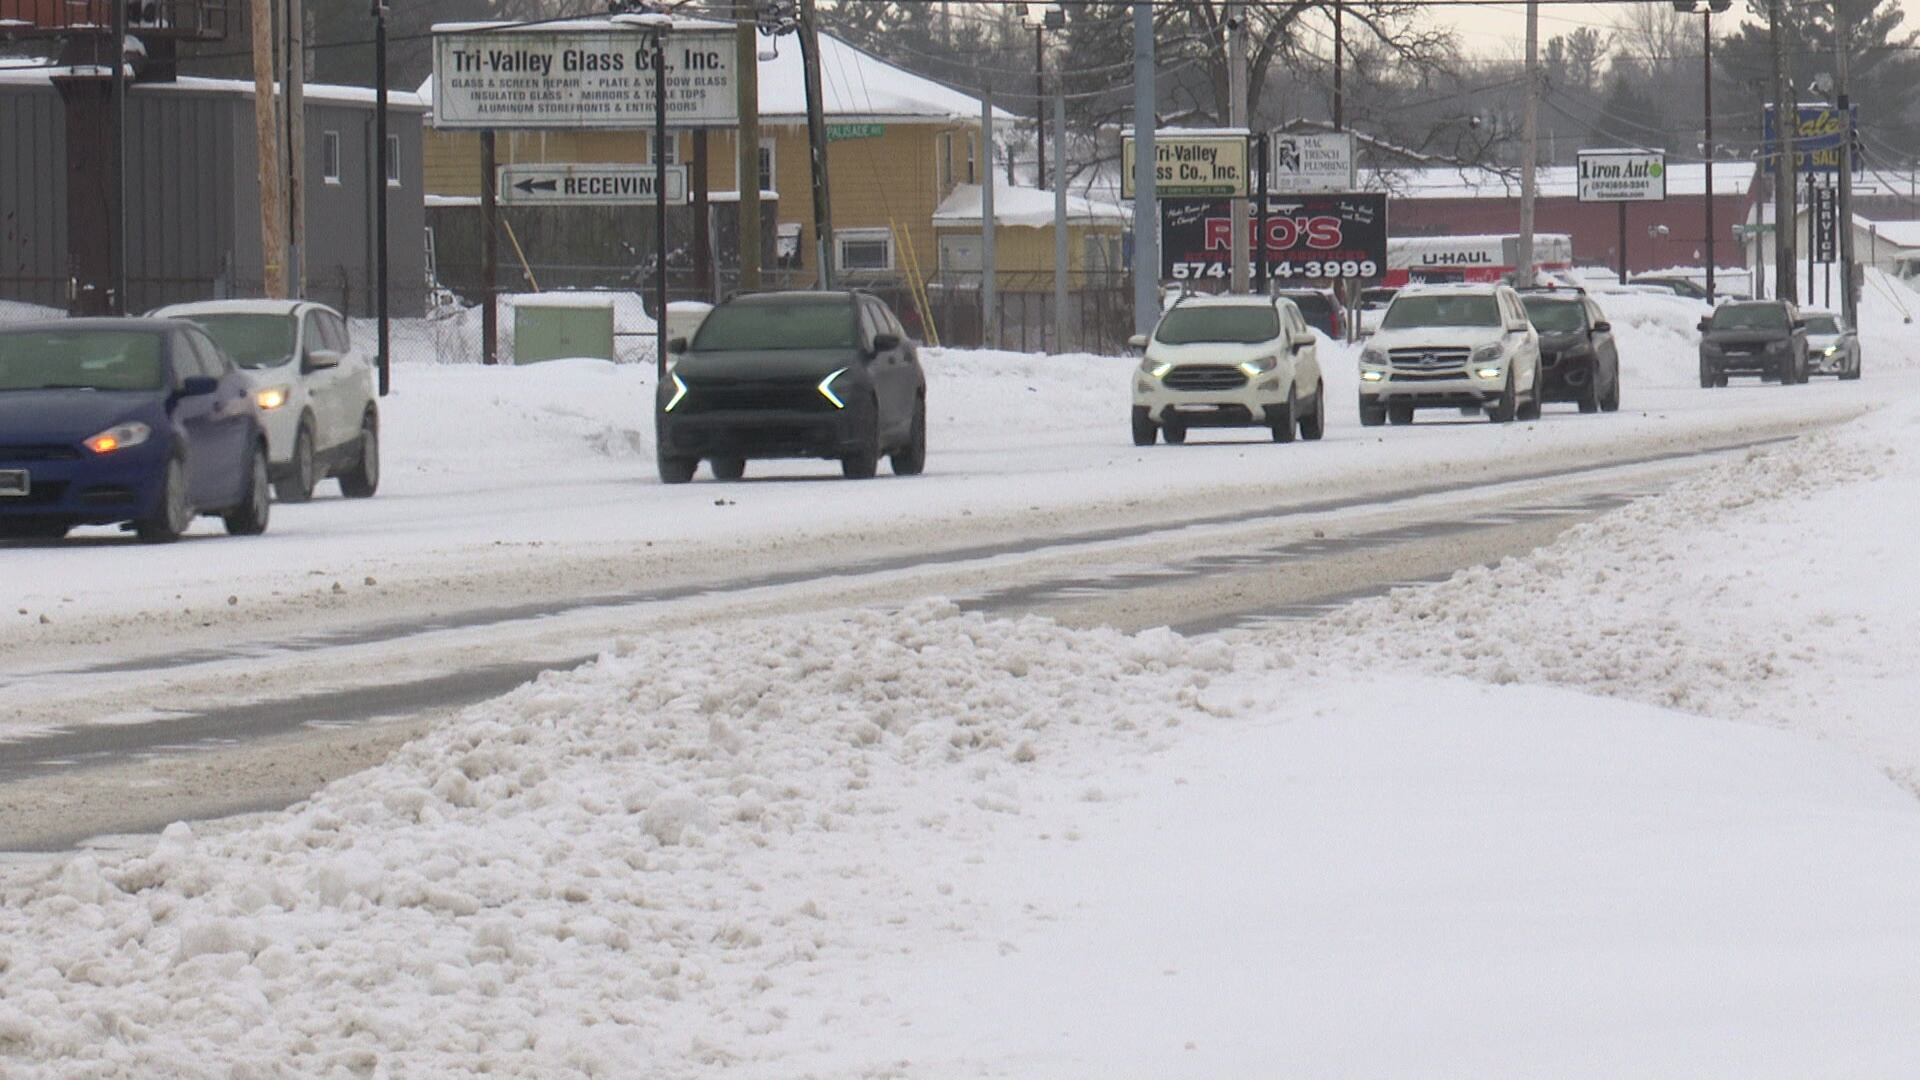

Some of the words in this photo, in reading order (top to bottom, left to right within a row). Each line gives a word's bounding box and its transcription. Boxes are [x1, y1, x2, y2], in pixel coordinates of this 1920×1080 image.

[453, 49, 552, 76] Tri-Valley
[563, 49, 624, 71] Glass
[685, 48, 725, 71] Inc.
[451, 79, 484, 88] GLASS
[488, 79, 495, 88] &
[499, 79, 539, 88] SCREEN
[543, 79, 580, 88] REPAIR
[599, 78, 631, 88] PLATE
[633, 78, 641, 87] &
[644, 77, 691, 87] WDOW
[694, 76, 727, 86] GLASS
[470, 91, 526, 101] INSULATED
[530, 91, 562, 100] GLASS
[581, 90, 630, 100] MIRRORS
[633, 90, 641, 99] &
[645, 89, 677, 99] TALE
[681, 89, 706, 99] TOPS
[477, 103, 534, 113] ALUMINUM
[538, 102, 610, 113] STOREFRONTS
[614, 102, 622, 112] &
[1304, 149, 1340, 160] TRENCH
[1180, 163, 1207, 181] Co.,
[1212, 164, 1240, 180] Inc.
[1304, 160, 1349, 171] PLUMBING
[1591, 160, 1621, 178] iron
[564, 177, 658, 195] RECEIVIN
[1204, 215, 1342, 250] RIO'S
[1820, 189, 1832, 261] SERVICE
[1422, 250, 1492, 265] U-HAUL
